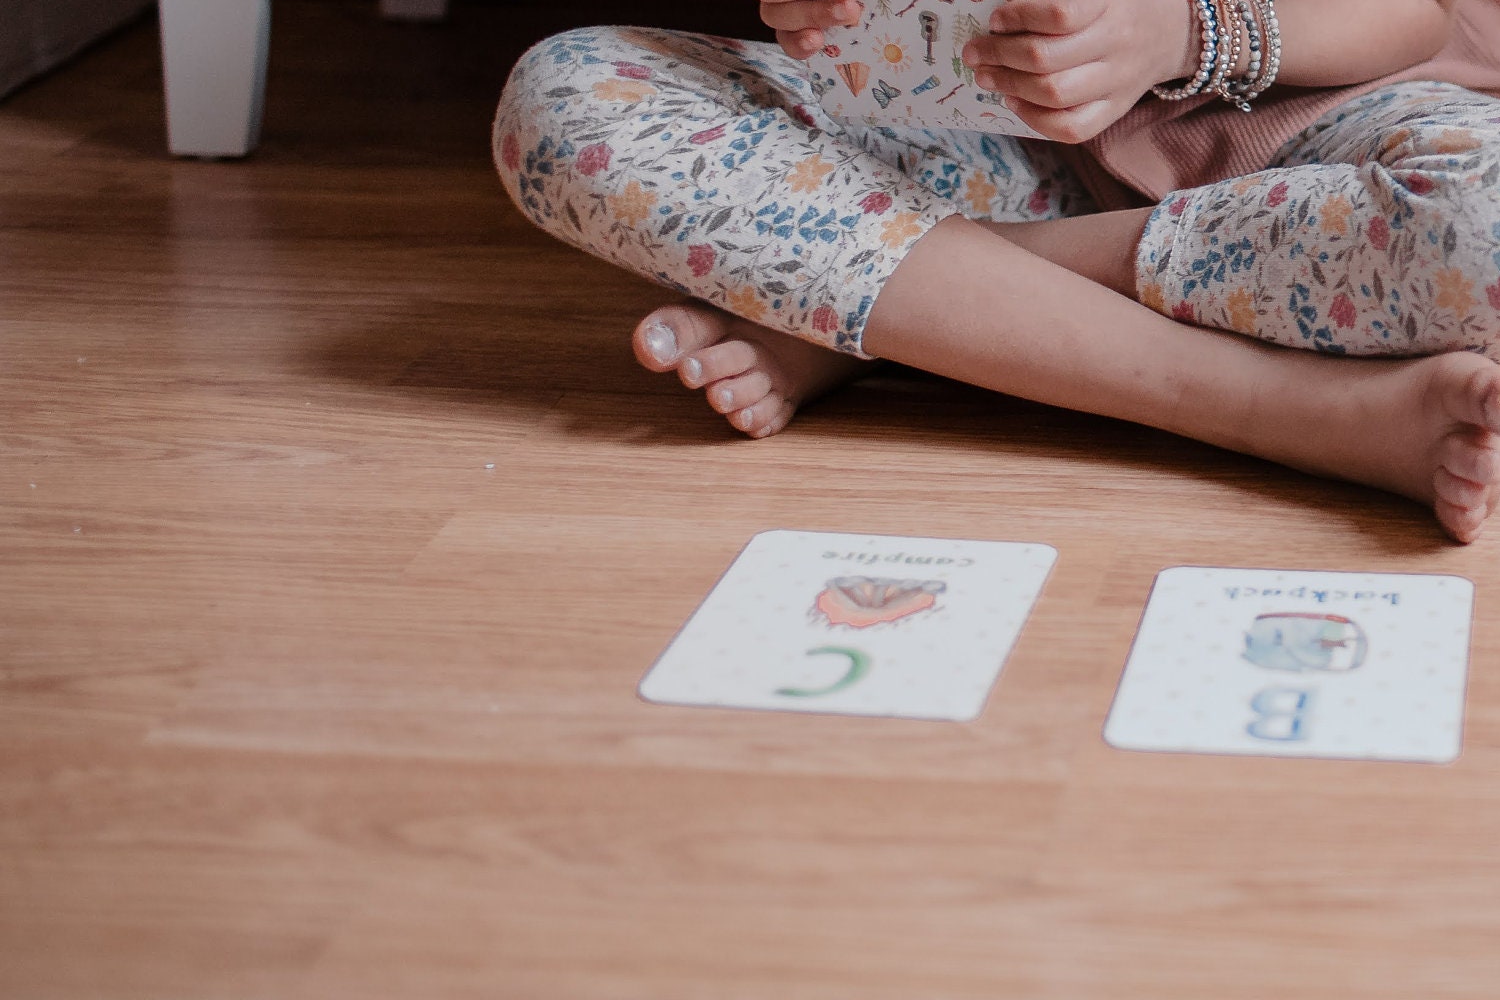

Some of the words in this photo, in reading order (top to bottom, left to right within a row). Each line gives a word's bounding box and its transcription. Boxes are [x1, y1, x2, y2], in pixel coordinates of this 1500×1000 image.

[822, 549, 977, 567] campfire
[1223, 586, 1400, 606] backpack
[772, 643, 872, 698] C
[1246, 685, 1318, 742] B
